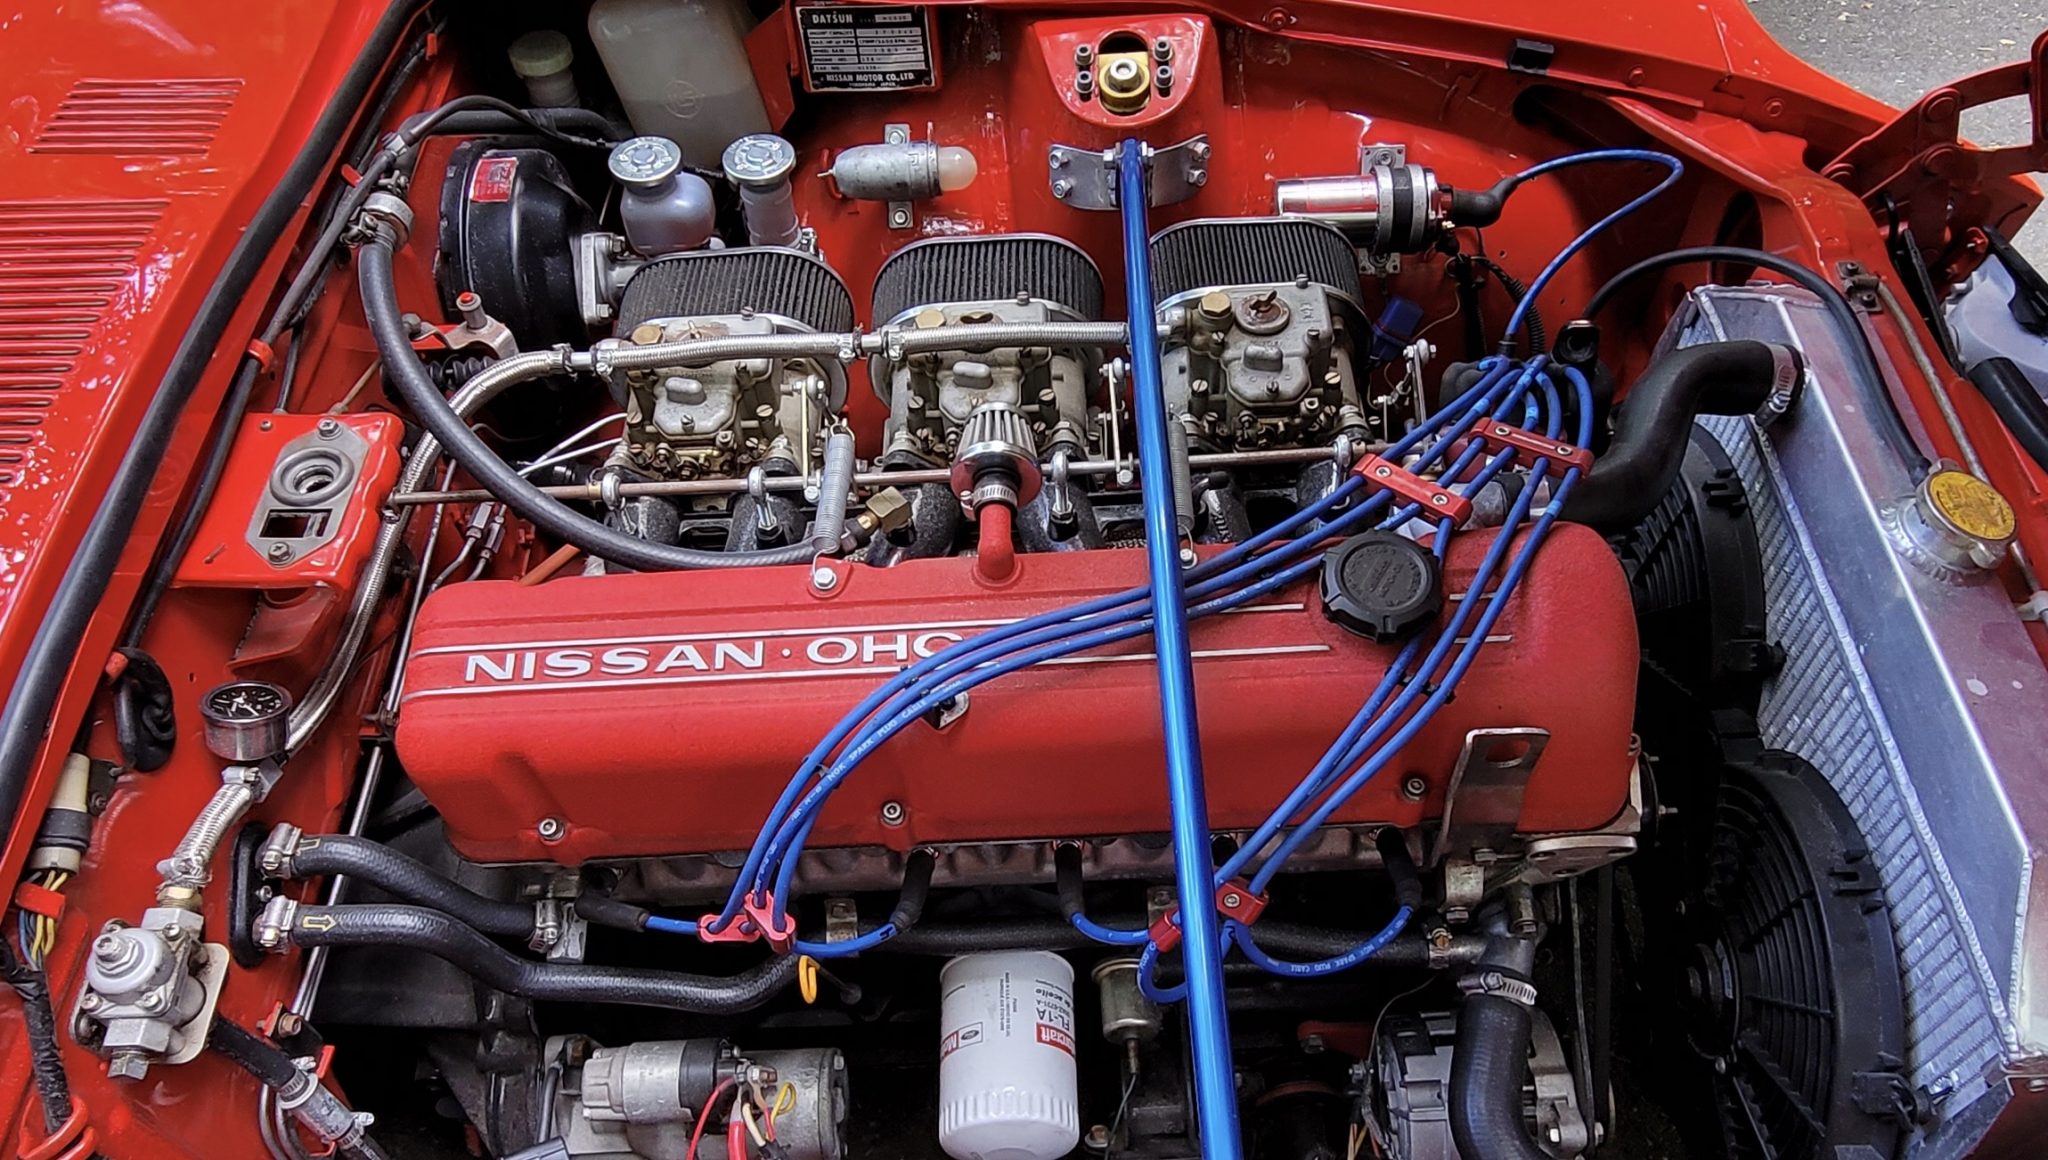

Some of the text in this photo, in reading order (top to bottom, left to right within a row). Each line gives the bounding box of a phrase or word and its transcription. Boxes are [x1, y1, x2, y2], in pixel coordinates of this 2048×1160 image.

[812, 13, 853, 24] DATSUN
[826, 74, 854, 82] NISSAN
[856, 73, 883, 82] MOTOR
[464, 632, 965, 682] NISSAN OHC
[849, 738, 875, 762] SPARK
[1035, 988, 1064, 1002] aceite
[1036, 1007, 1070, 1032] FL-1A
